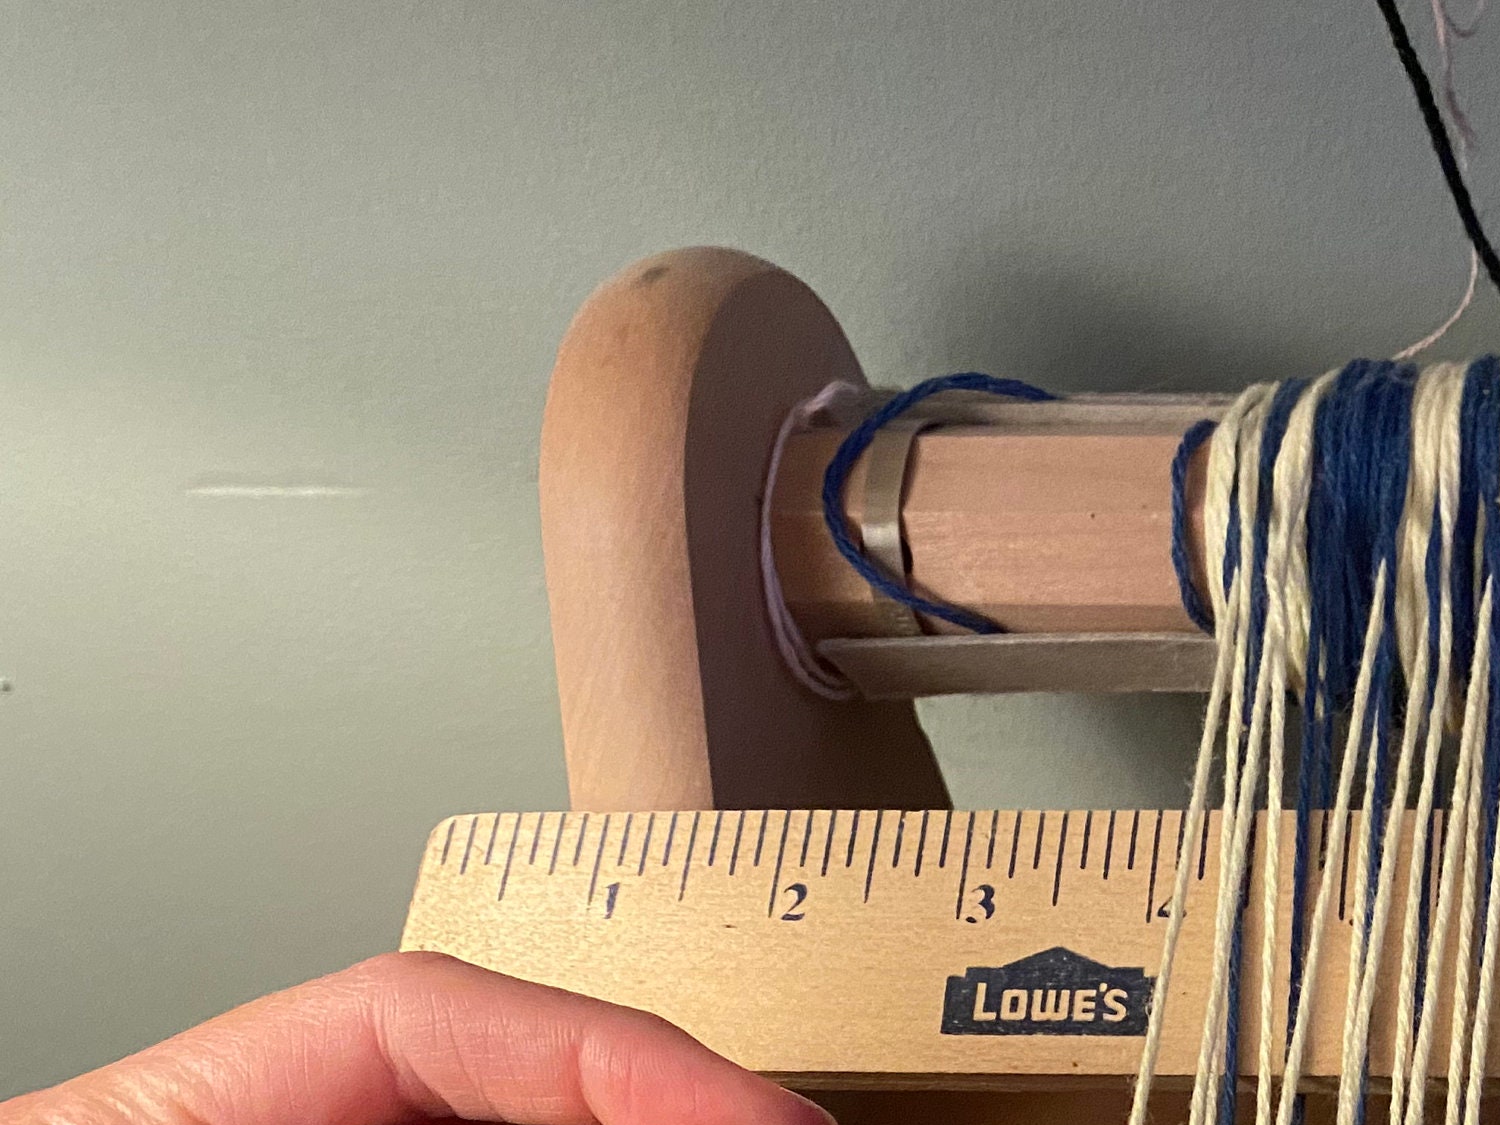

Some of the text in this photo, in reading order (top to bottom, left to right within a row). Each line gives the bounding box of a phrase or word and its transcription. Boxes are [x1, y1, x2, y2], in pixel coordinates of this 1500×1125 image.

[604, 882, 620, 920] 1
[781, 882, 808, 921] 2
[965, 884, 996, 924] 3
[972, 981, 1129, 1023] LOWE'S
